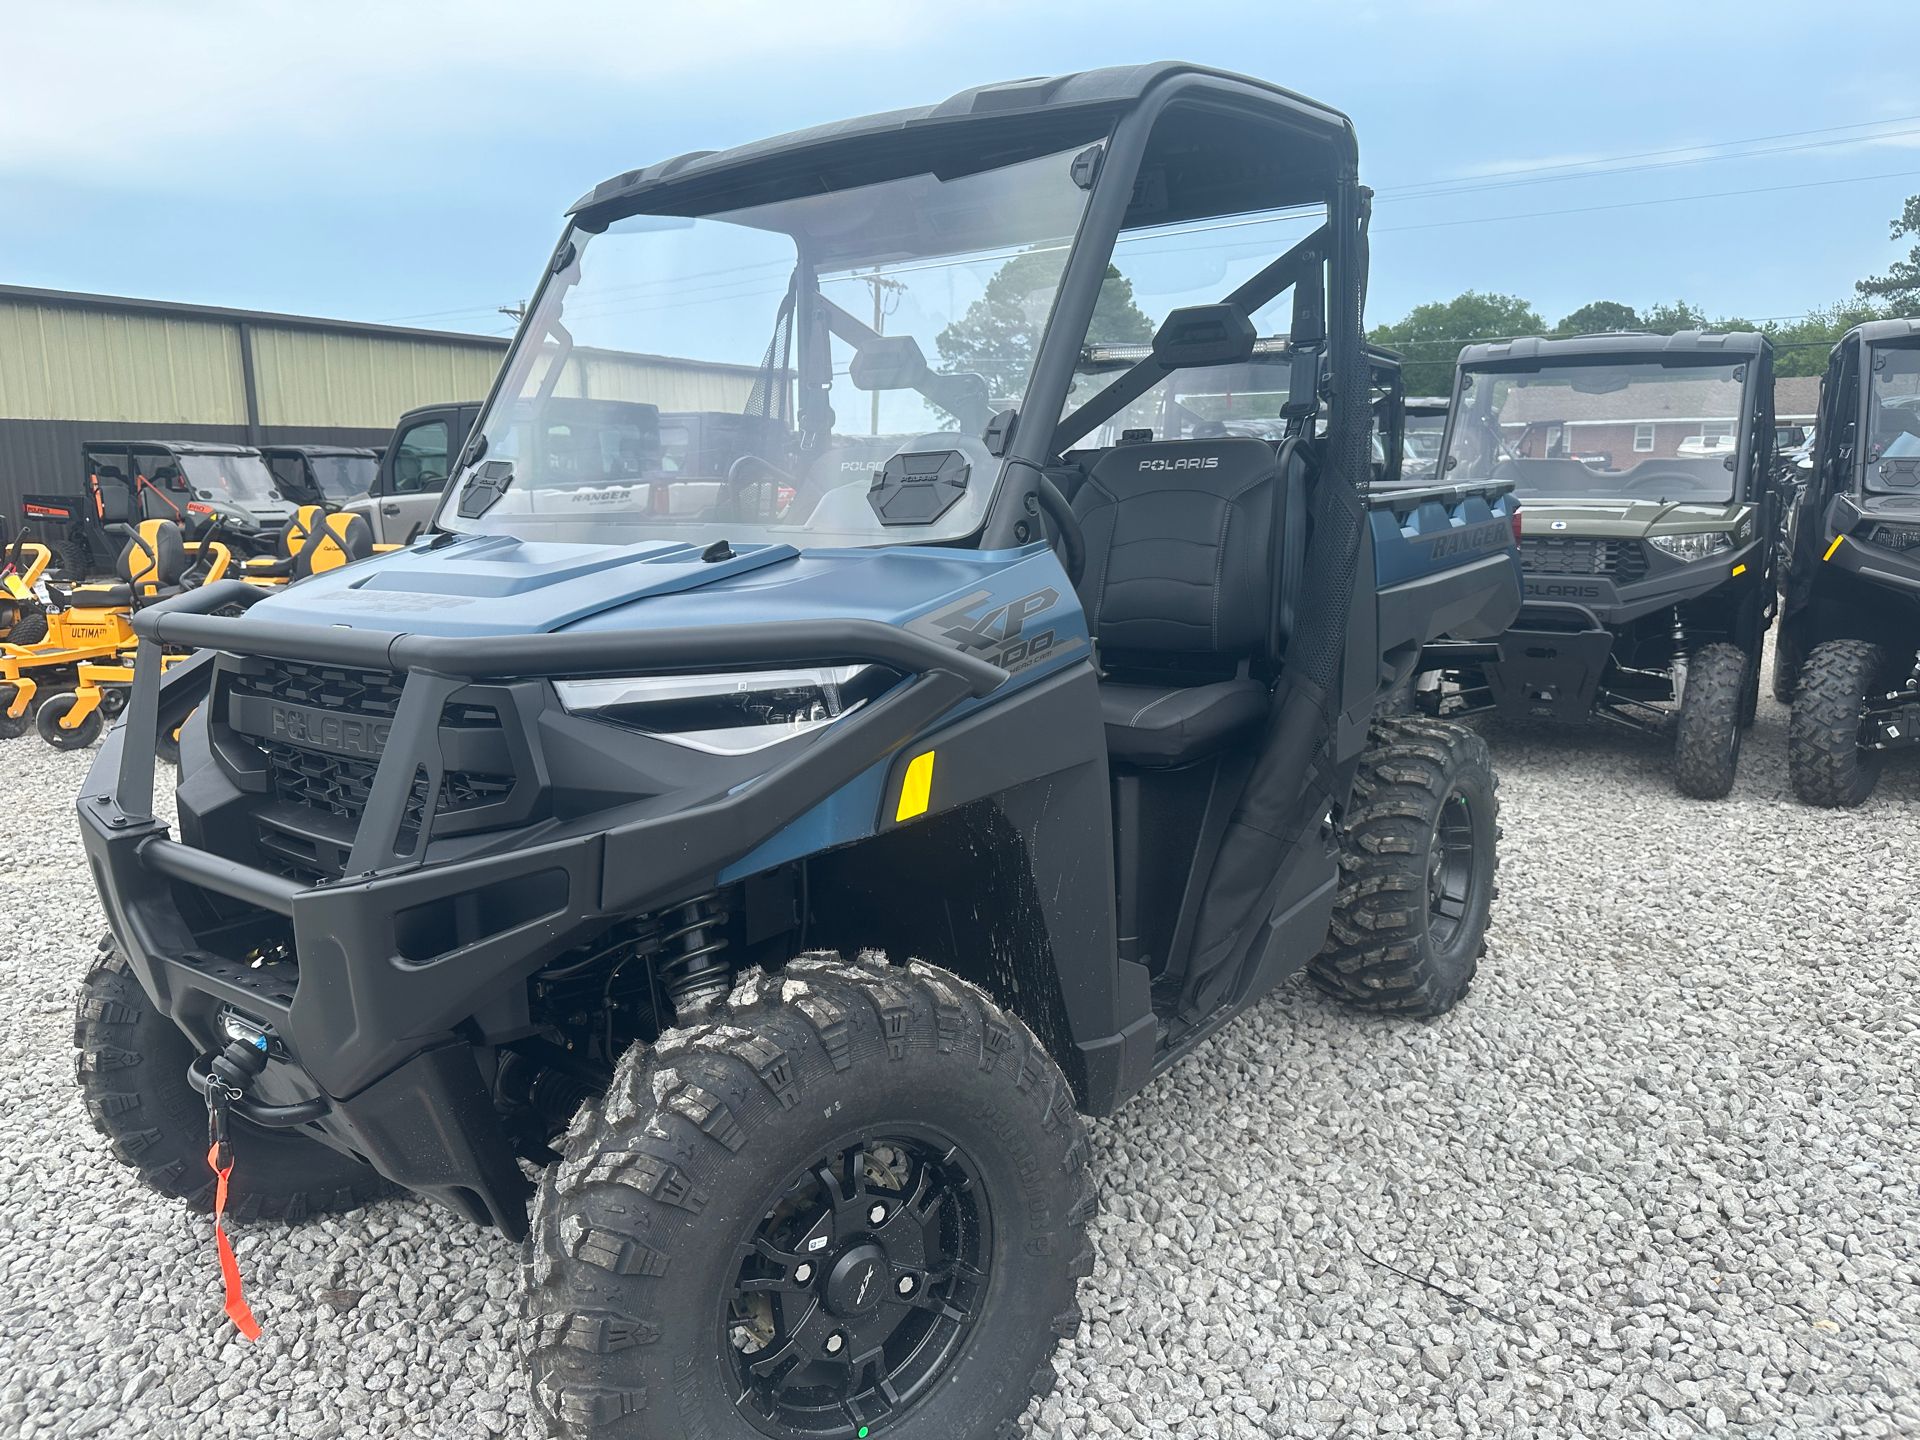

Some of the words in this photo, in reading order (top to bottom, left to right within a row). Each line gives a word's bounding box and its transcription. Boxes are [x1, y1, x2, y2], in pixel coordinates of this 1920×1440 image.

[1138, 457, 1219, 472] POLARIS
[572, 490, 632, 502] RANGER
[1431, 522, 1507, 560] RANGER
[940, 584, 1062, 652] XP
[71, 627, 100, 639] ULTIMA
[271, 706, 393, 755] POLARIS
